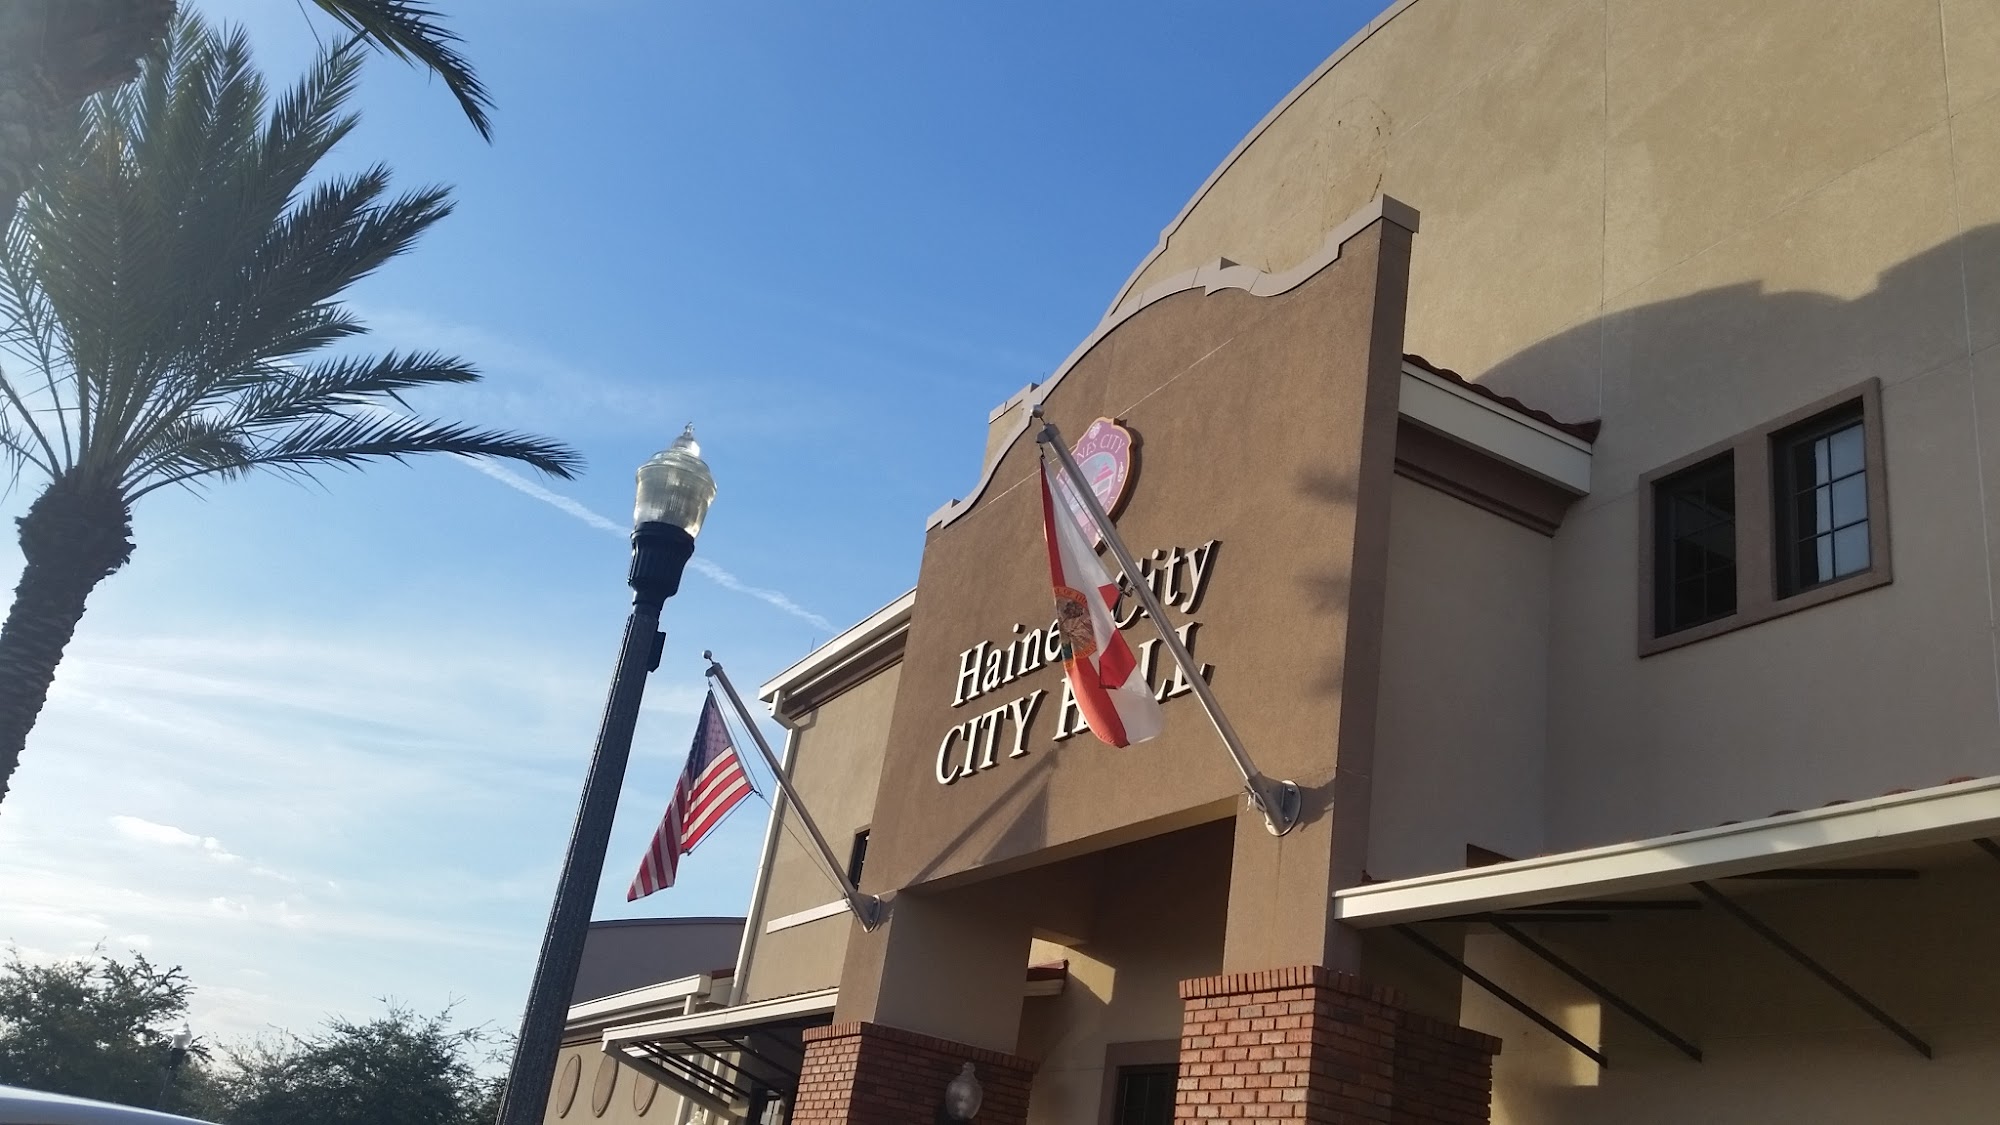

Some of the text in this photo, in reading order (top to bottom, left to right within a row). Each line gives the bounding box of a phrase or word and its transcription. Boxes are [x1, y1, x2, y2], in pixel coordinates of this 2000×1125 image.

[1100, 433, 1125, 454] CITY
[936, 622, 1207, 784] CITY HLL
[951, 619, 1063, 707] Haine
